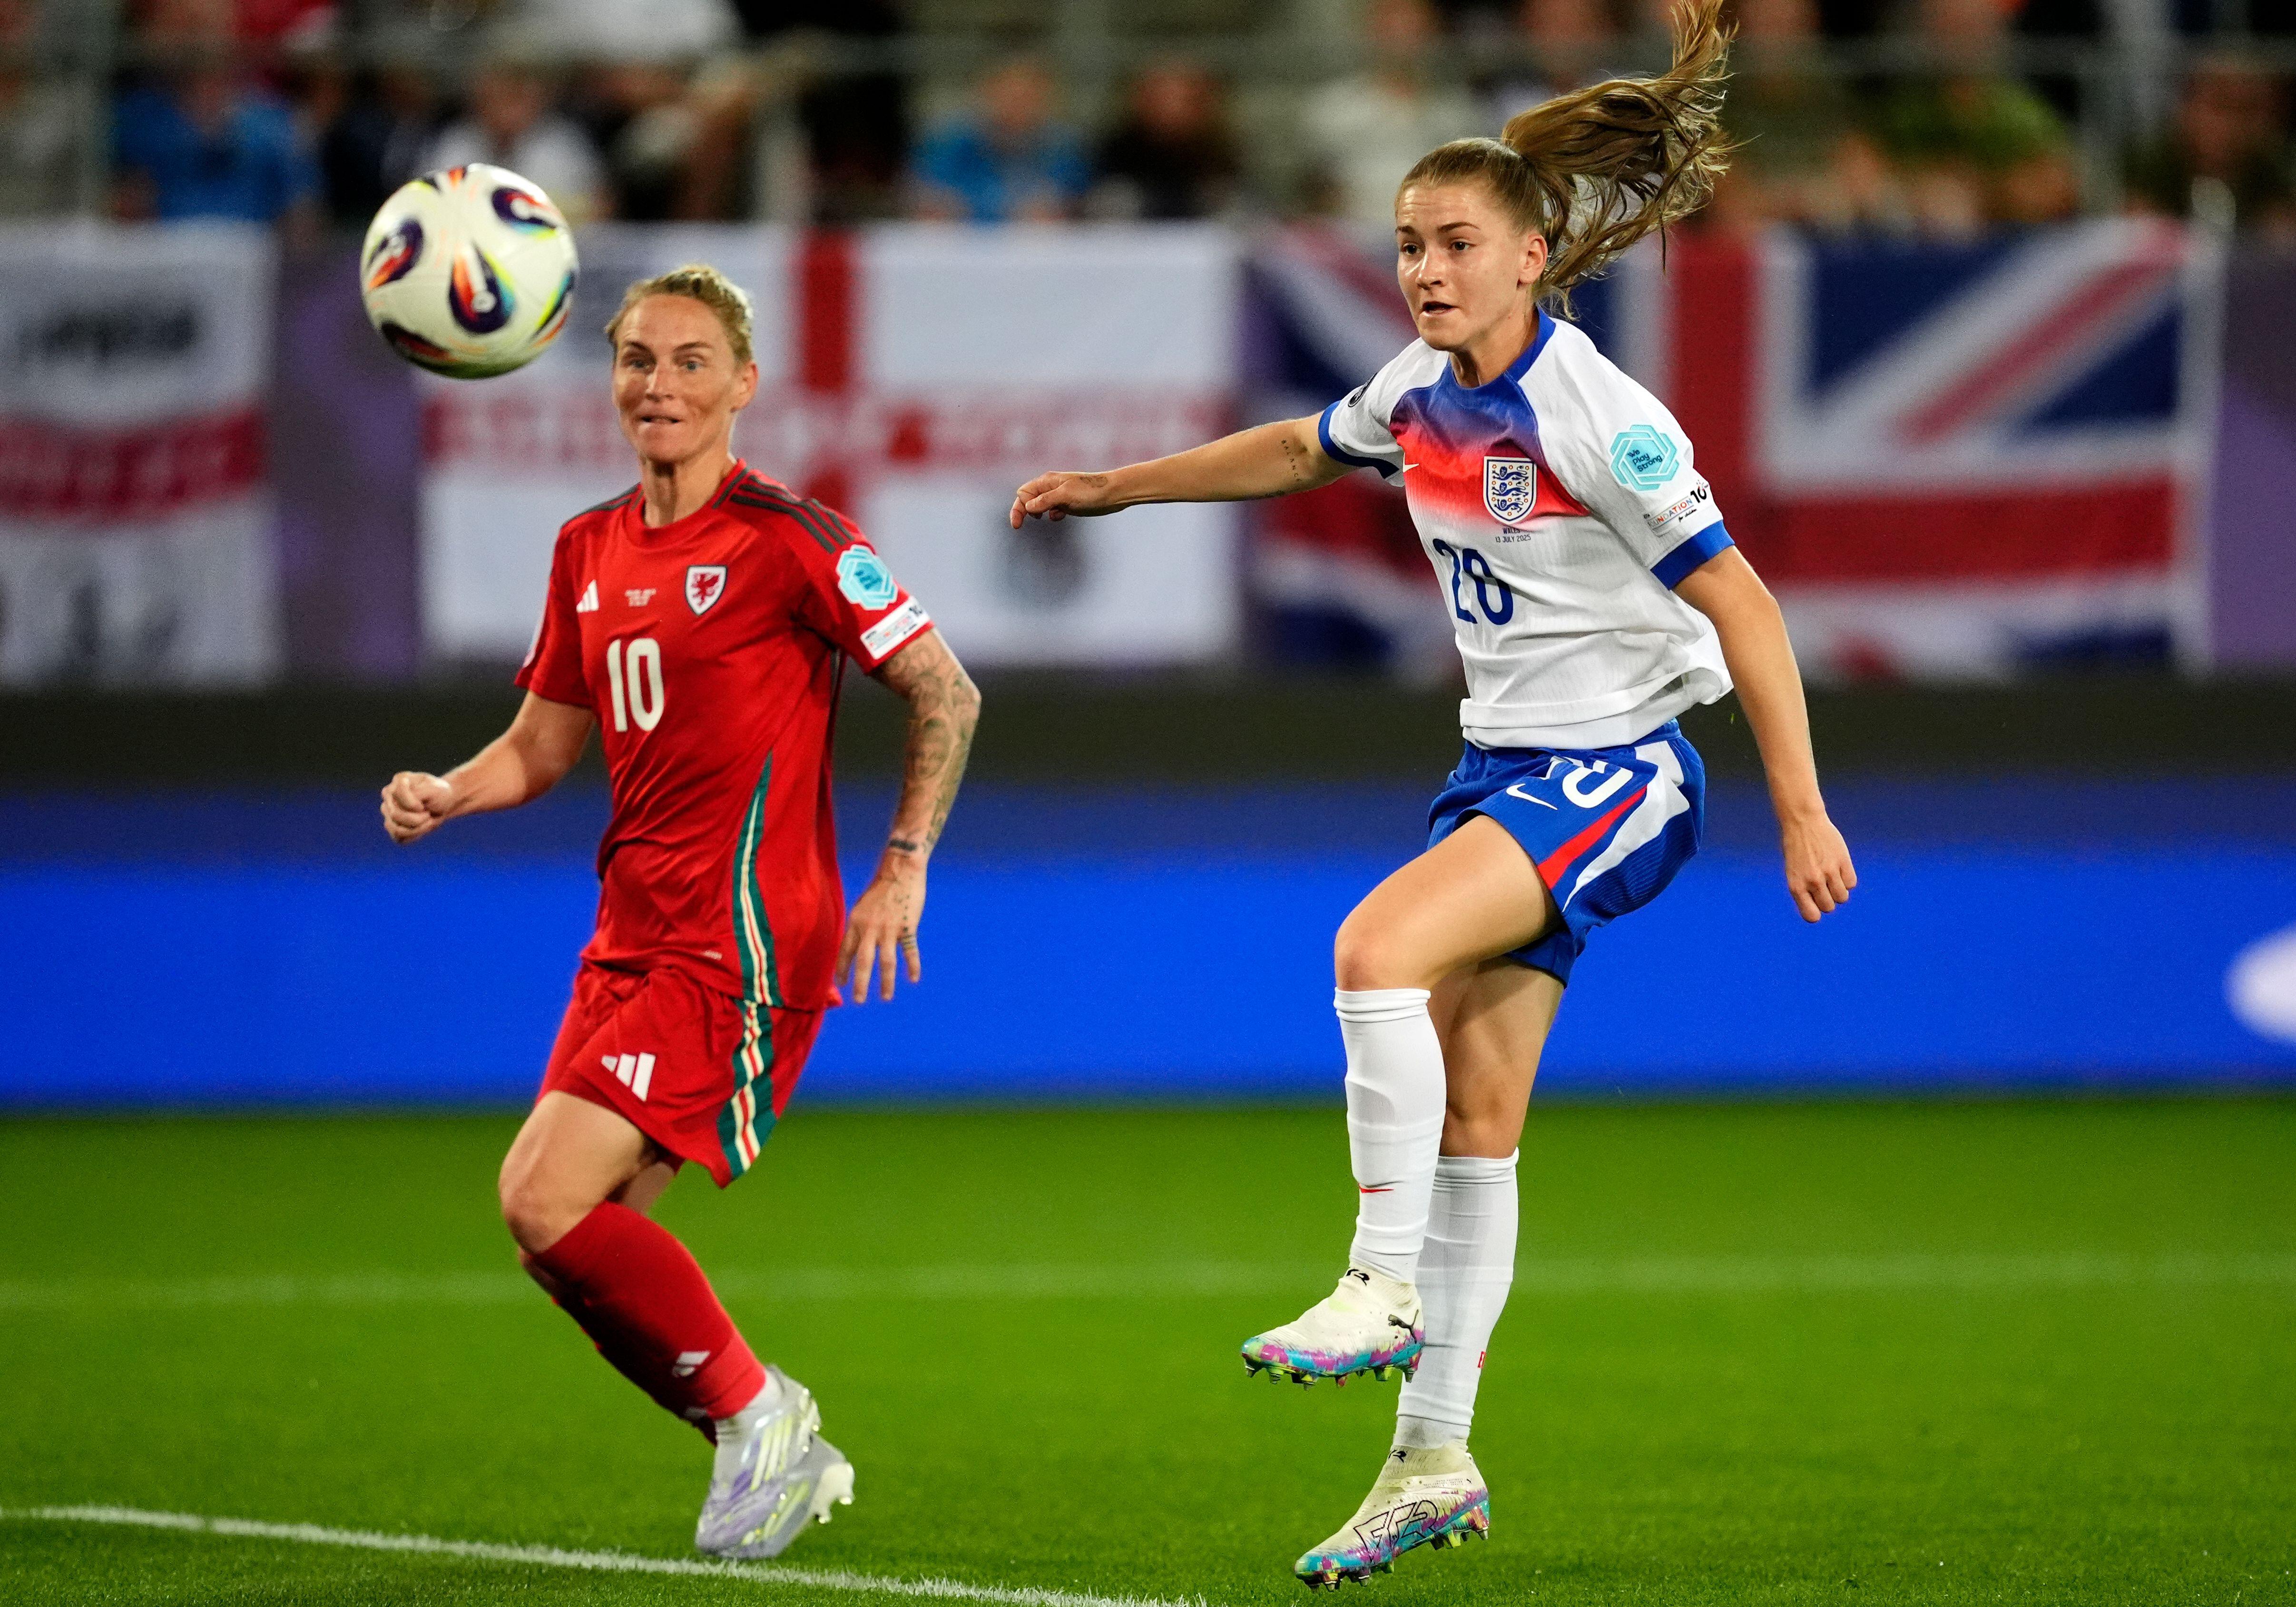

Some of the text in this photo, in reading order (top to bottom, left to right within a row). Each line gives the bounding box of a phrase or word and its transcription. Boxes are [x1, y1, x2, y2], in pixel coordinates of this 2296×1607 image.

[1628, 449, 1640, 457] We
[1517, 533, 1531, 542] 2025
[1433, 538, 1513, 625] 20
[606, 637, 664, 733] 10
